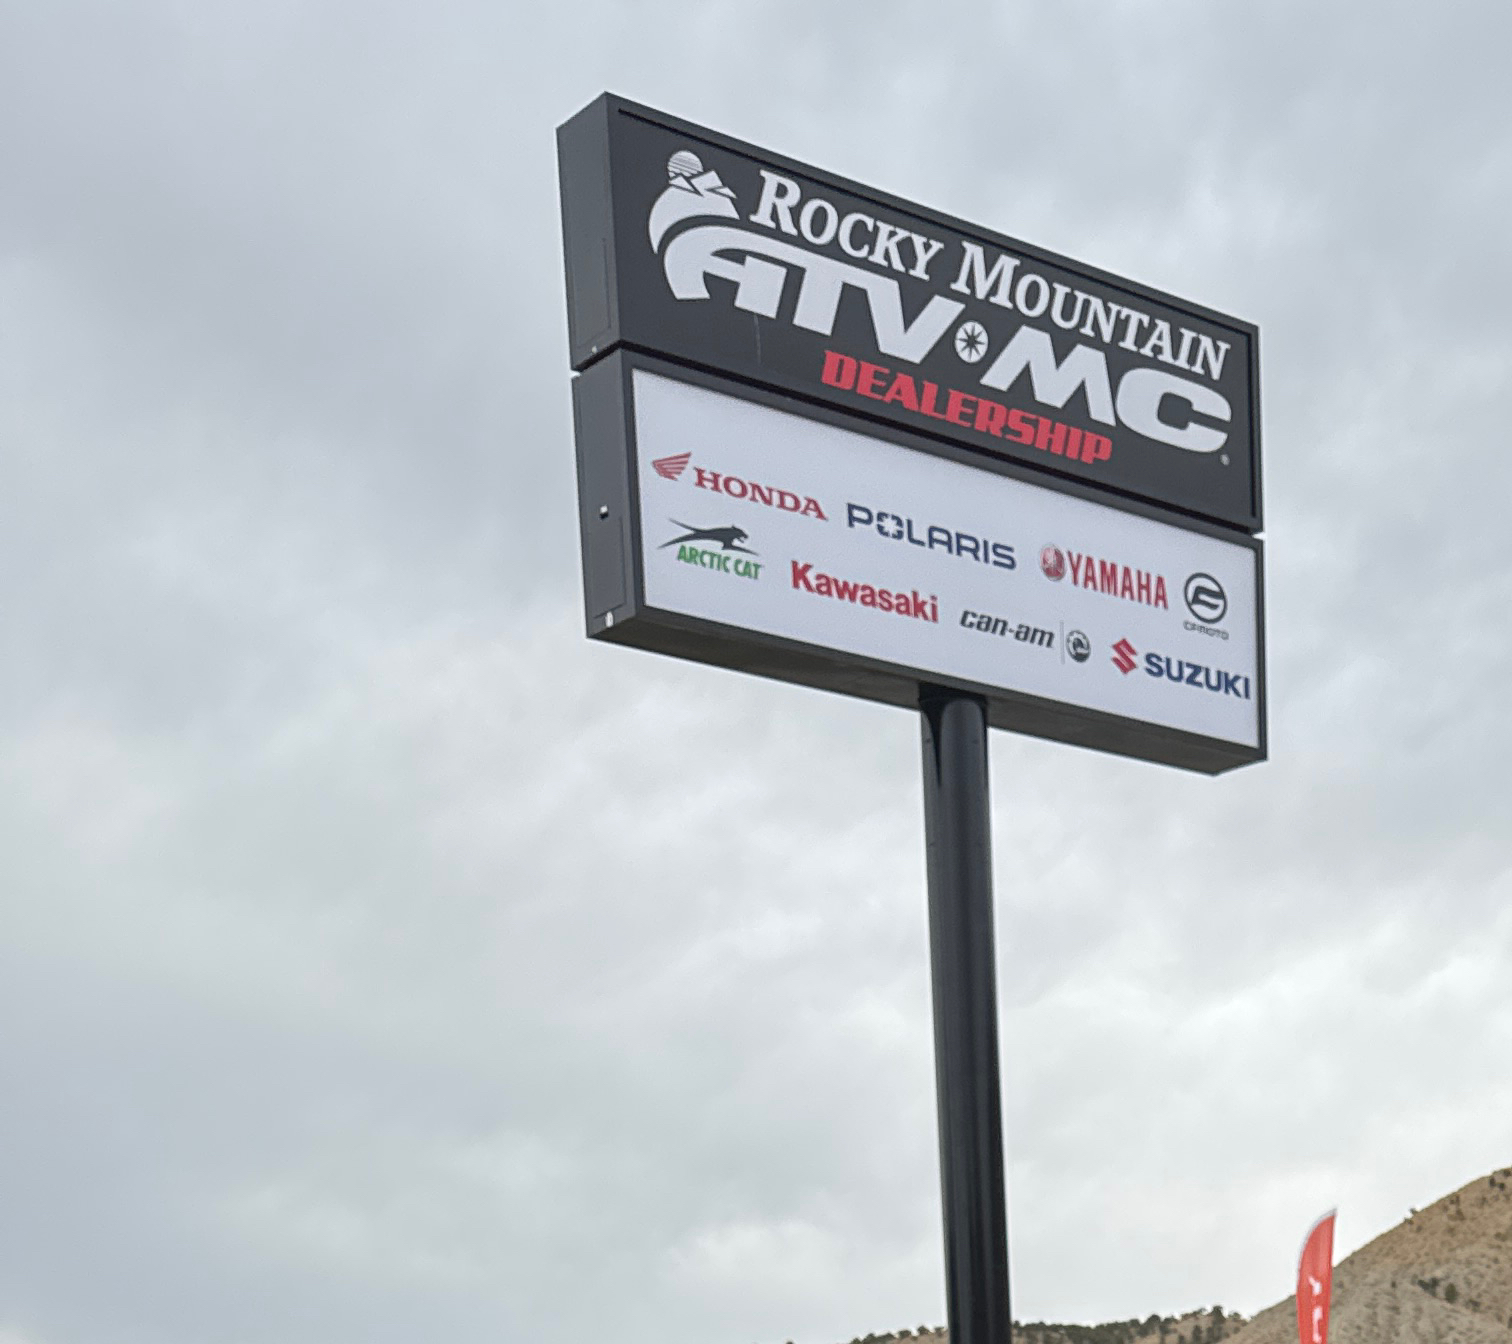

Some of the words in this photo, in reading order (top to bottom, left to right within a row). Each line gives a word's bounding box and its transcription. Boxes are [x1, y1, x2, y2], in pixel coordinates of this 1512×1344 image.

[749, 169, 945, 280] ROCKY
[950, 240, 1231, 380] MOUNTAIN
[821, 350, 1113, 465] DEALERSHIP
[693, 467, 827, 521] HONDA
[677, 544, 731, 575] ARCTIC
[732, 558, 762, 581] CAT
[847, 504, 1017, 570] POLARIS
[790, 560, 940, 623] Kawasaki
[1066, 550, 1169, 611] YAMAHA
[960, 609, 1056, 649] can-am
[1144, 652, 1252, 701] SUZUKI
